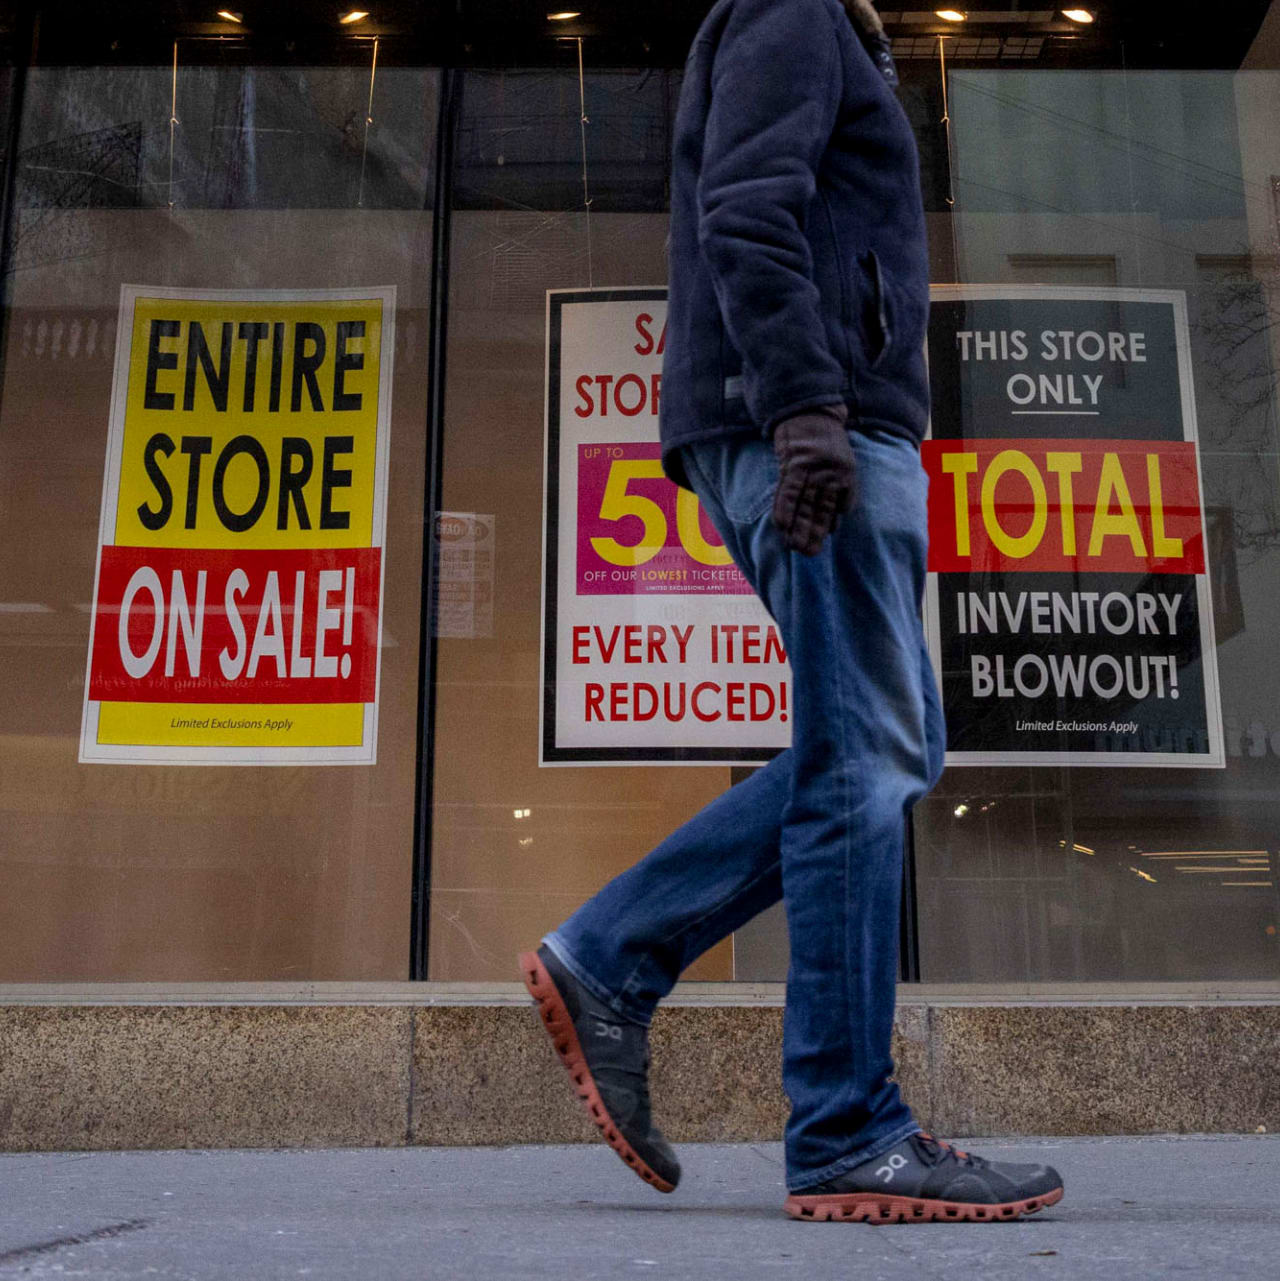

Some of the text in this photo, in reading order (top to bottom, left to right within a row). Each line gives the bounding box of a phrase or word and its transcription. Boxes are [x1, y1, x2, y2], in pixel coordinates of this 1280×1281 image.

[143, 319, 367, 413] ENTIRE
[957, 330, 1147, 362] THIS STORE
[1006, 374, 1103, 405] ONLY
[584, 446, 624, 458] UP TO
[137, 432, 355, 533] STORE
[941, 449, 1184, 559] TOTAL
[584, 571, 607, 582] OFF
[611, 571, 637, 581] OUR
[641, 570, 688, 581] LOWEST
[118, 565, 207, 680] ON
[219, 566, 356, 682] SALE!
[957, 591, 1182, 635] INVENTORY
[572, 625, 695, 664] EVERY
[971, 653, 1180, 699] BLOWOUT!
[585, 682, 788, 723] REDUCED!
[170, 718, 293, 731] Limited Exclusions Apply
[1015, 720, 1138, 734] Limited Exclusions Apply
